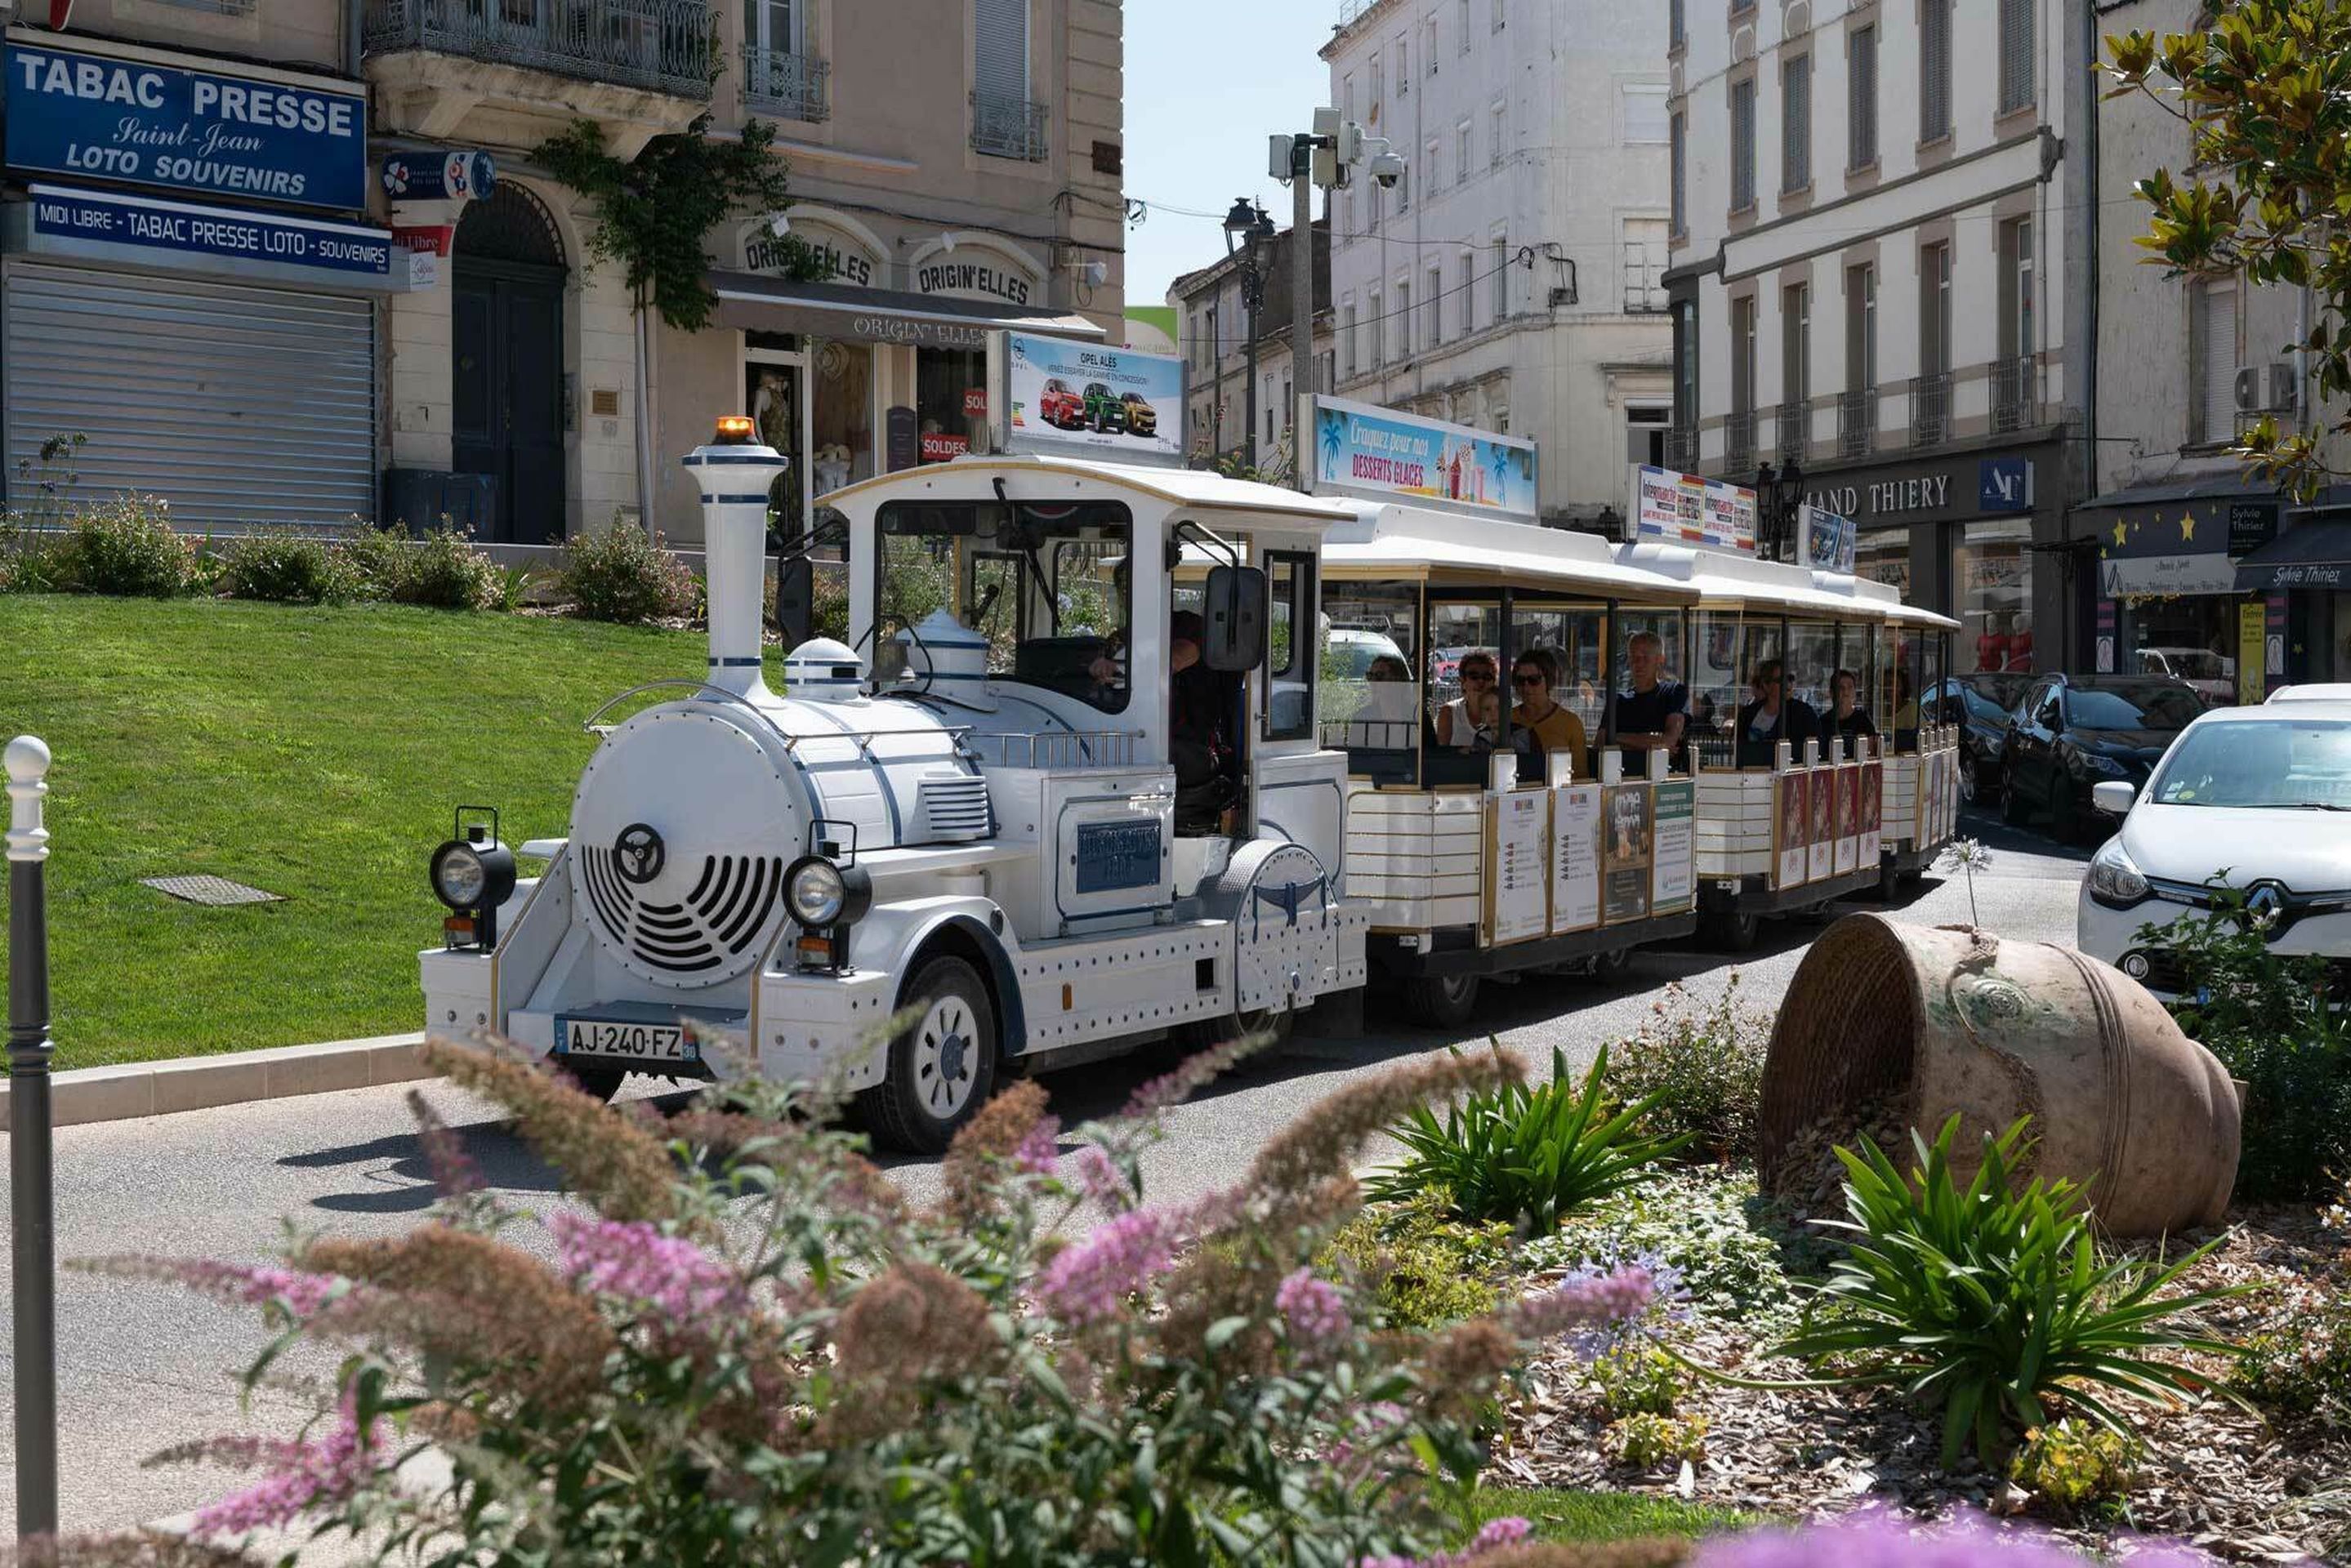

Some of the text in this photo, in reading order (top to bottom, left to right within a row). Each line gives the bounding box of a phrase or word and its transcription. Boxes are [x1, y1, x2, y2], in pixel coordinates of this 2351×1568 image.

[16, 52, 351, 137] TABAC PRESSE
[113, 117, 263, 157] Saint-Jean
[66, 144, 306, 195] LOTO SOUVENIRS
[41, 204, 69, 225] MIDI
[73, 209, 112, 229] LIBRE
[127, 213, 186, 242] TABAC
[191, 220, 258, 250] PRESSE
[265, 230, 306, 255] LOTO
[319, 240, 386, 264] SOUVENIRS
[1080, 353, 1098, 366] OPEL
[966, 394, 987, 409] SOL
[924, 439, 966, 455] SOLDES
[1351, 418, 1429, 458] Craquez pour nos
[1352, 453, 1424, 488] DESSERTS GLACÉS
[1870, 474, 1948, 514] THIERY
[2233, 508, 2260, 519] Sylvie
[2233, 520, 2264, 531] Thiriez
[2273, 566, 2341, 587] Sylvie Thiriez
[572, 1024, 680, 1058] AJ-240-FZ
[684, 1045, 696, 1059] 30
